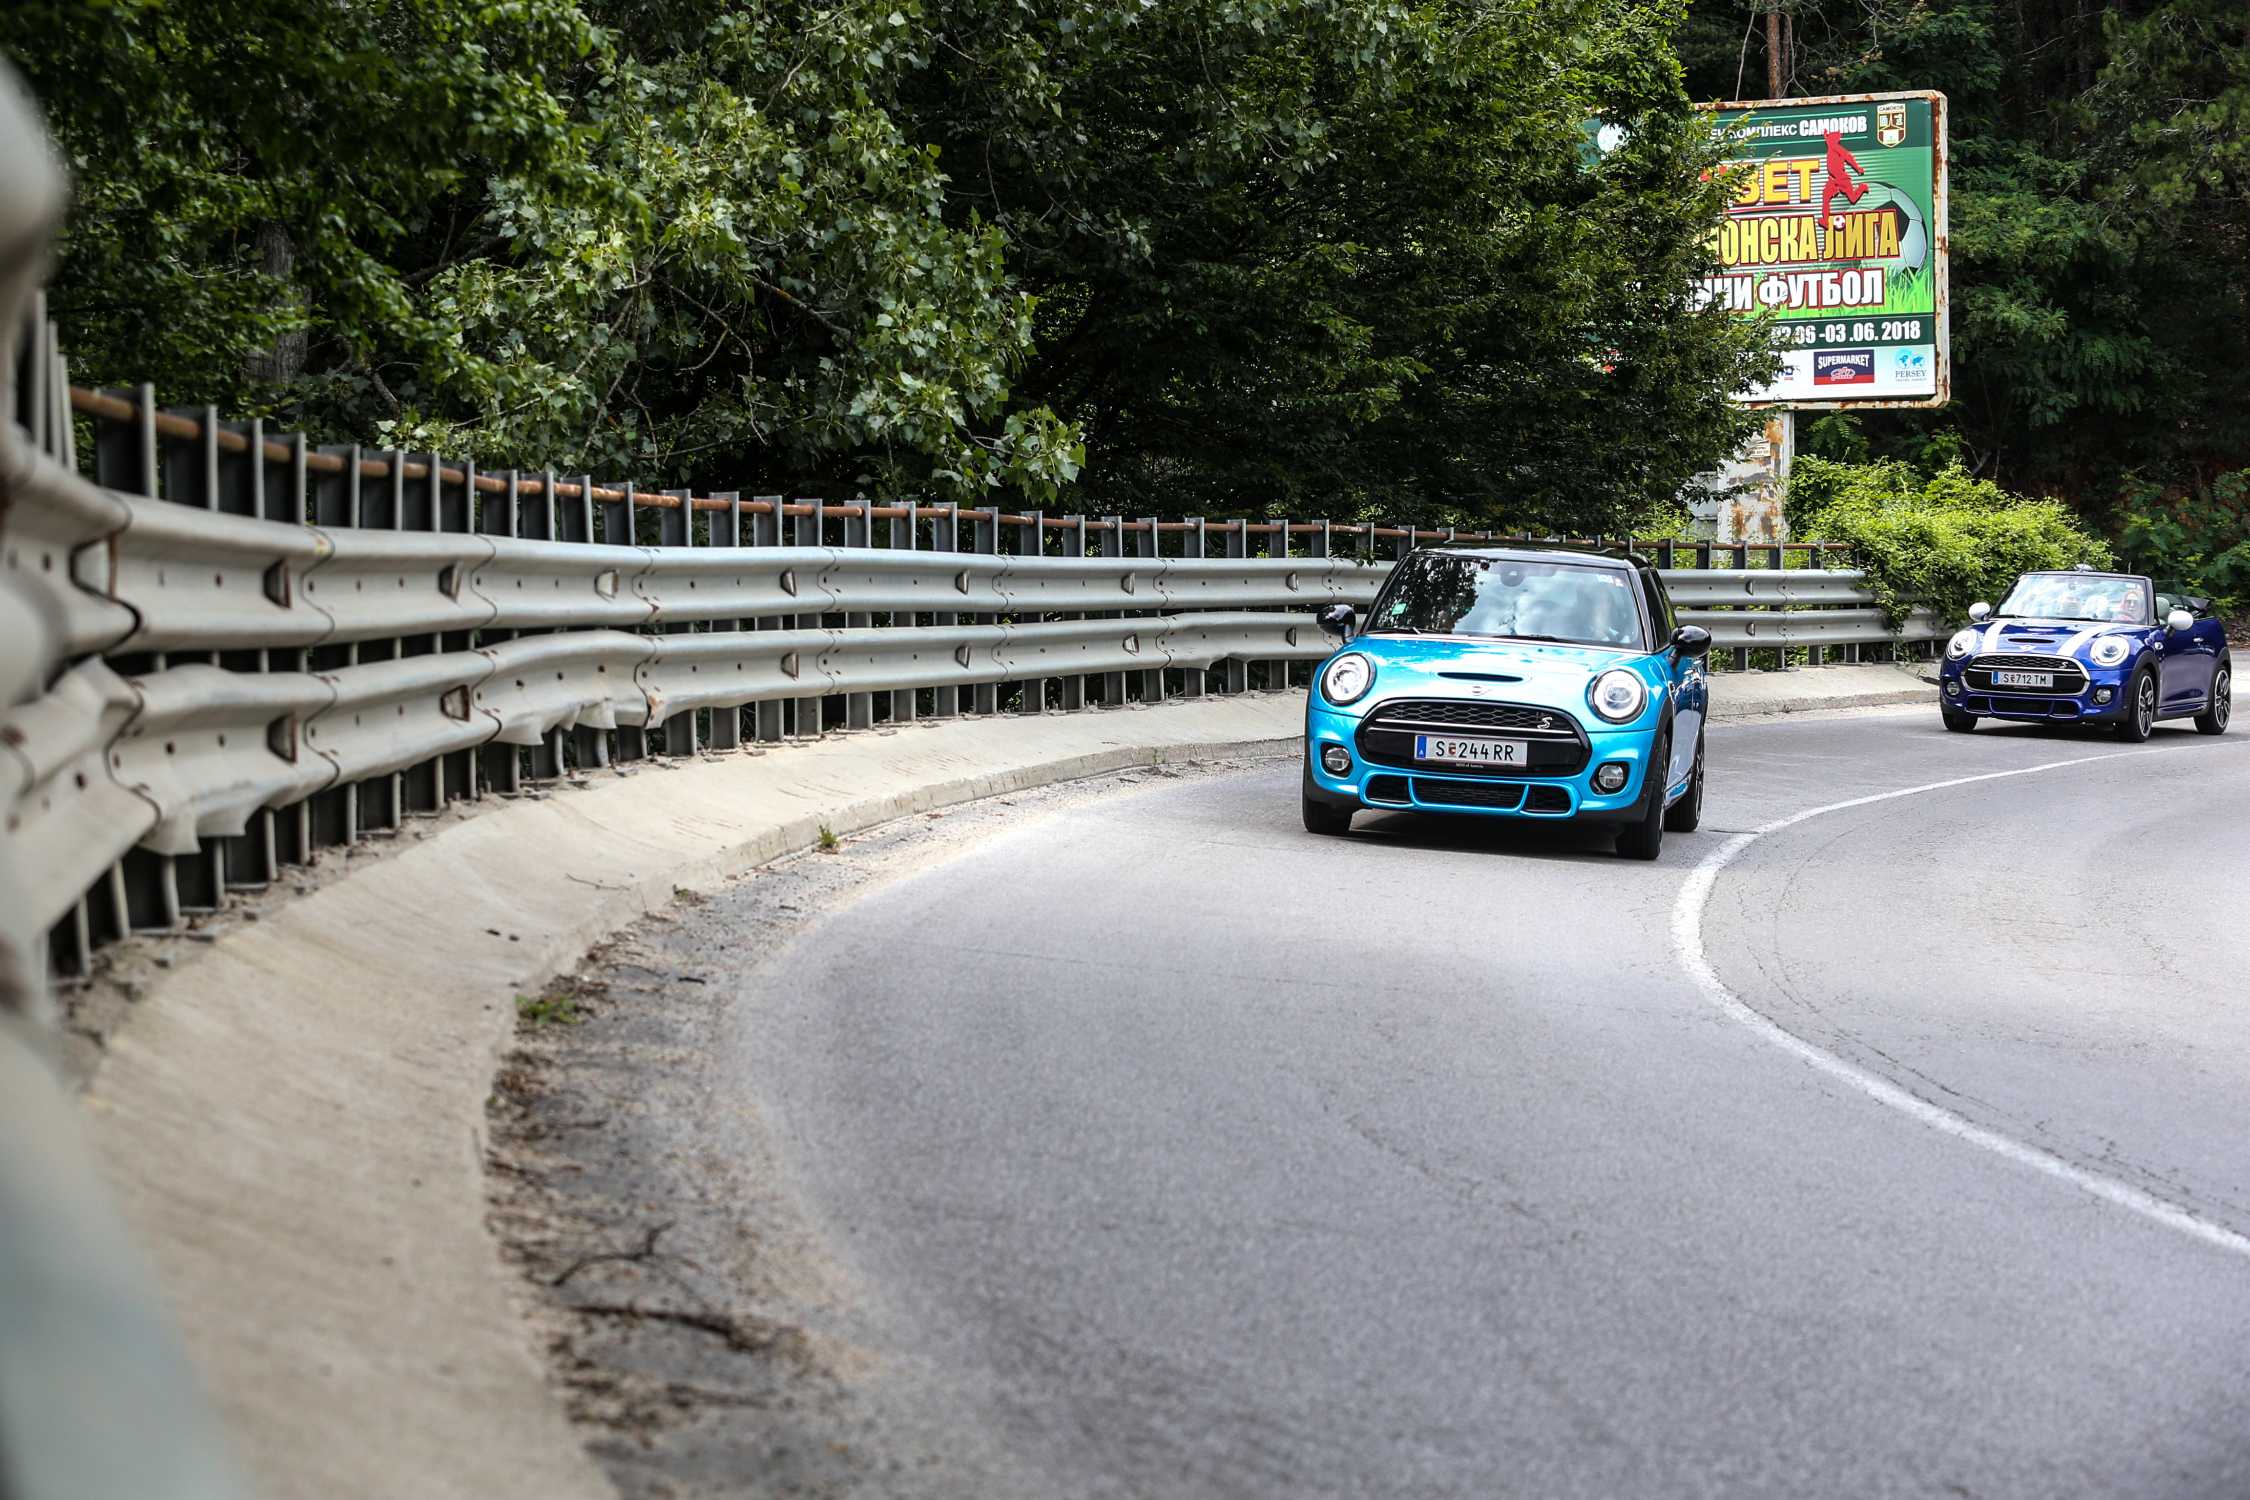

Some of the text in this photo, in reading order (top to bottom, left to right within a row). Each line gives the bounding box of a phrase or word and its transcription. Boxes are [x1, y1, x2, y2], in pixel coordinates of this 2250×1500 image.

[1799, 116, 1868, 137] САМОКОВ
[1823, 209, 1901, 260] ЛИГА
[1757, 269, 1885, 311] ФУТБОЛ
[1881, 320, 1921, 340] 2018
[1818, 354, 1870, 369] SUPERMARKET
